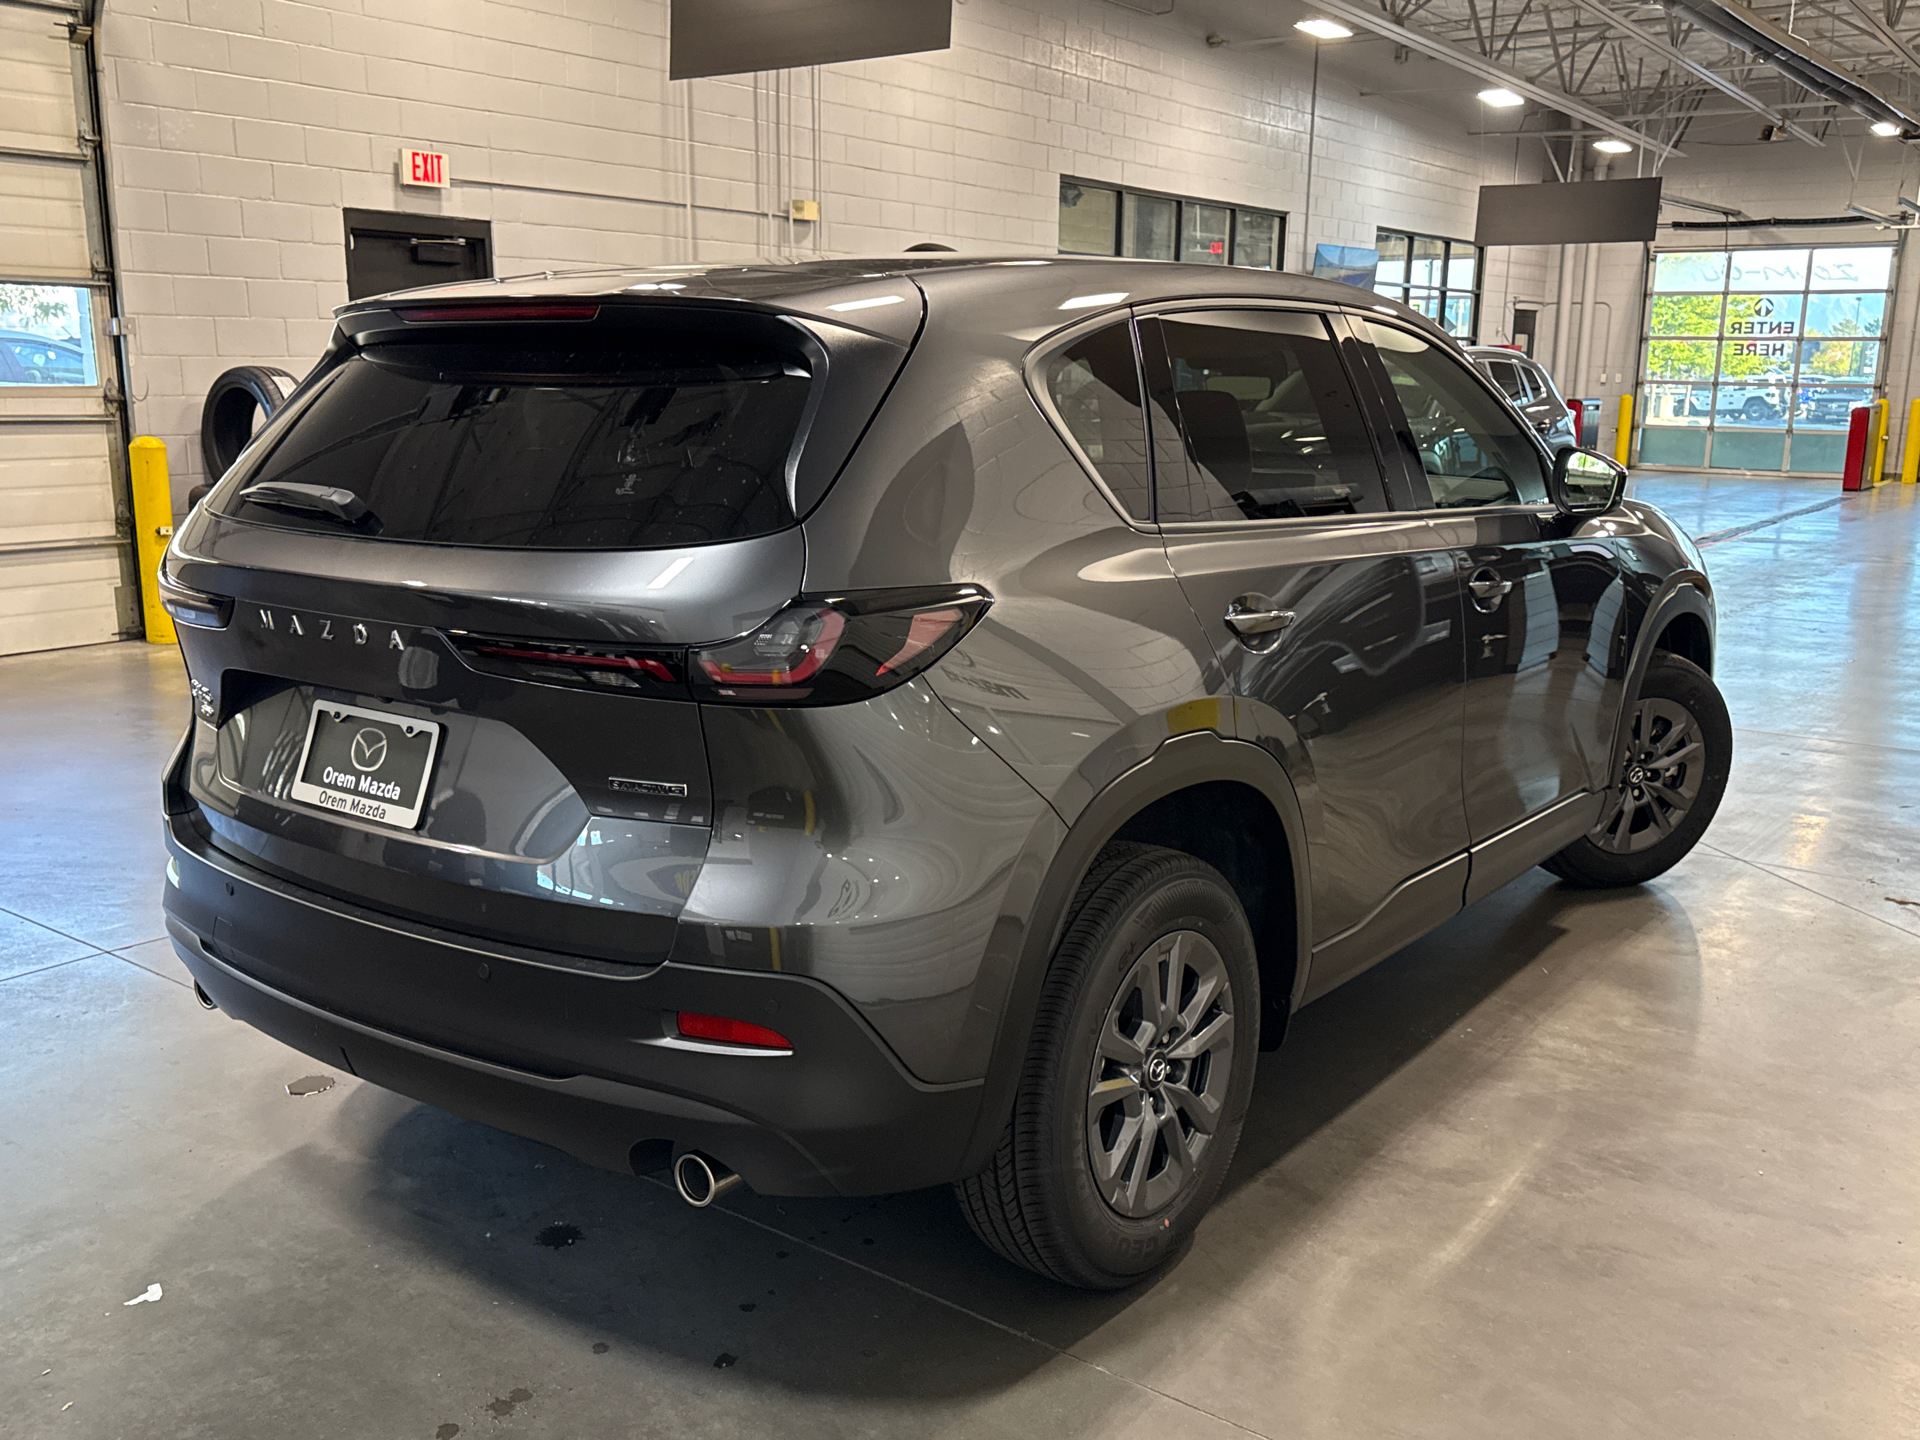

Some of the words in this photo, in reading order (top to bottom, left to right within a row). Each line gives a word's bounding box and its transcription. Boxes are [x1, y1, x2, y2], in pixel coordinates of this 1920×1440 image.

[411, 151, 443, 184] EXIT
[259, 608, 405, 651] MAZDA
[322, 766, 356, 790] Orem
[358, 774, 401, 801] Mazda
[318, 790, 347, 810] Orem
[349, 798, 387, 820] Mazda
